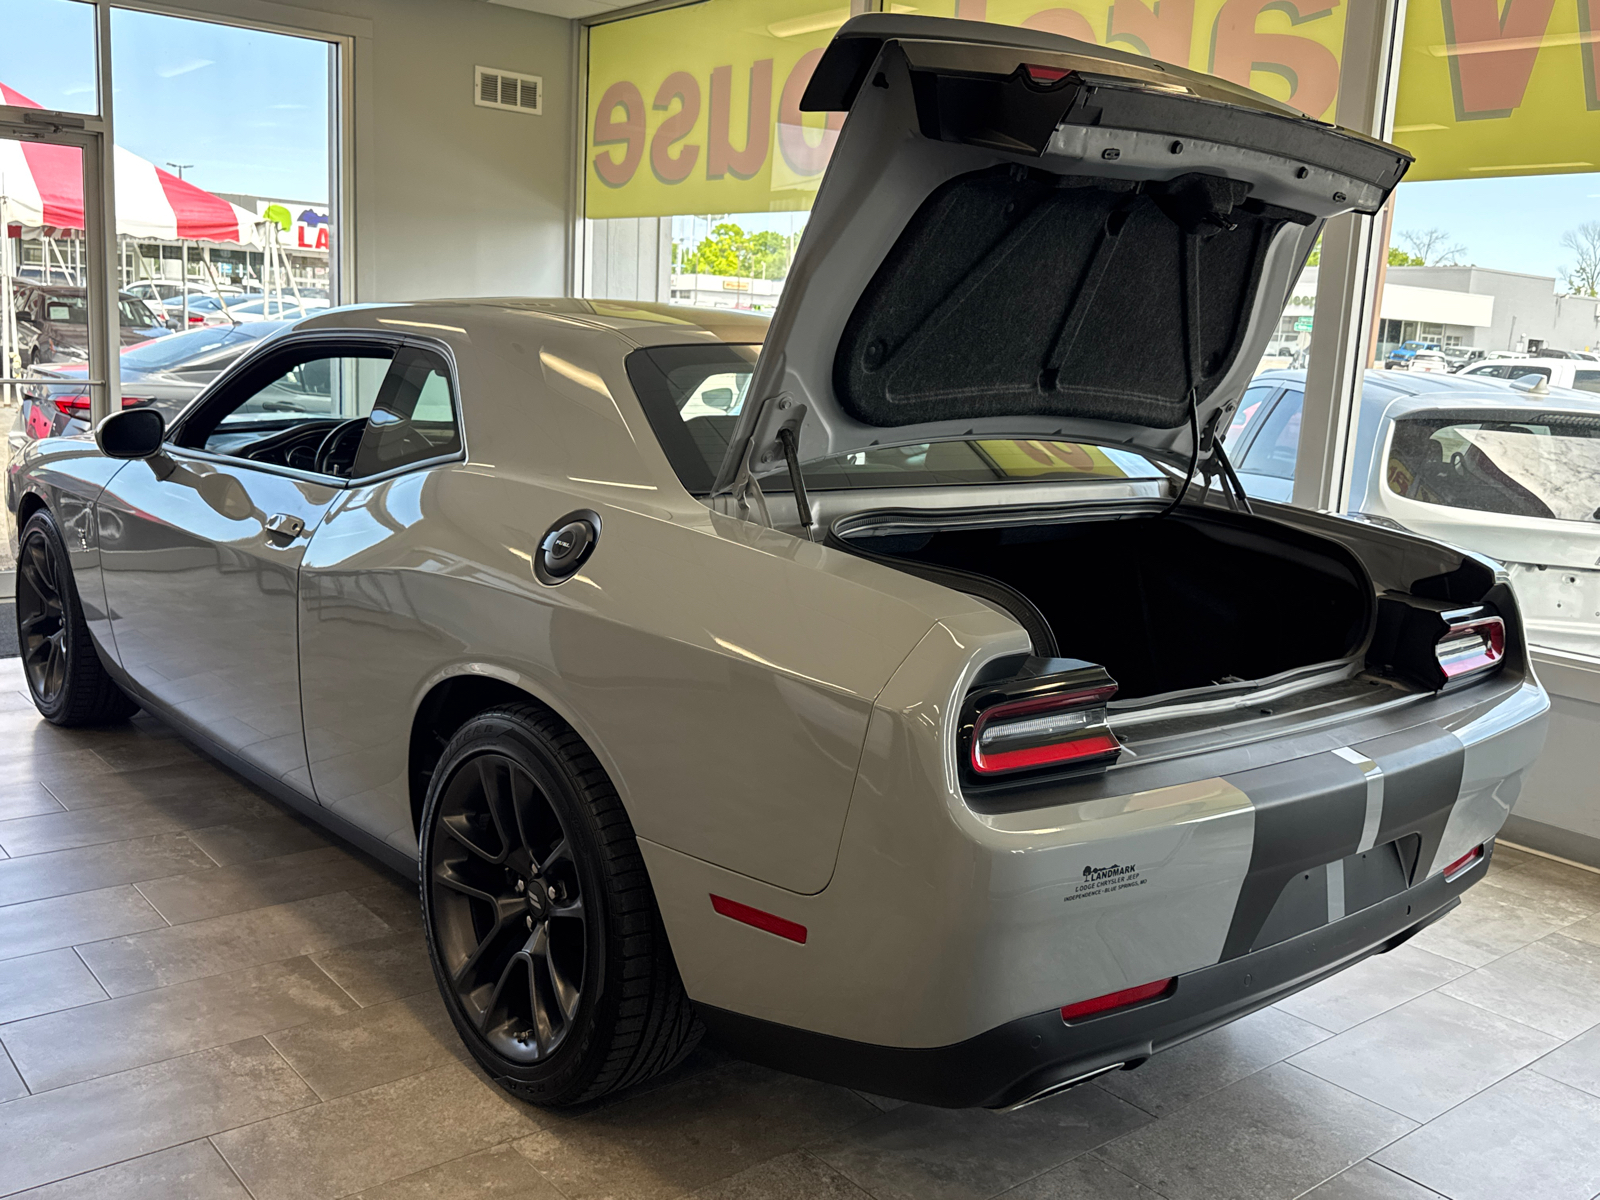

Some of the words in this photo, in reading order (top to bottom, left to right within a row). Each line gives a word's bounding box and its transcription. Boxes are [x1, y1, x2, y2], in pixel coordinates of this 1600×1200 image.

[555, 539, 570, 548] FUEL
[1091, 864, 1136, 881] LANDMARK
[1096, 876, 1125, 887] CHRYSLER
[1126, 872, 1140, 881] JEEP
[1104, 885, 1117, 893] BLUE
